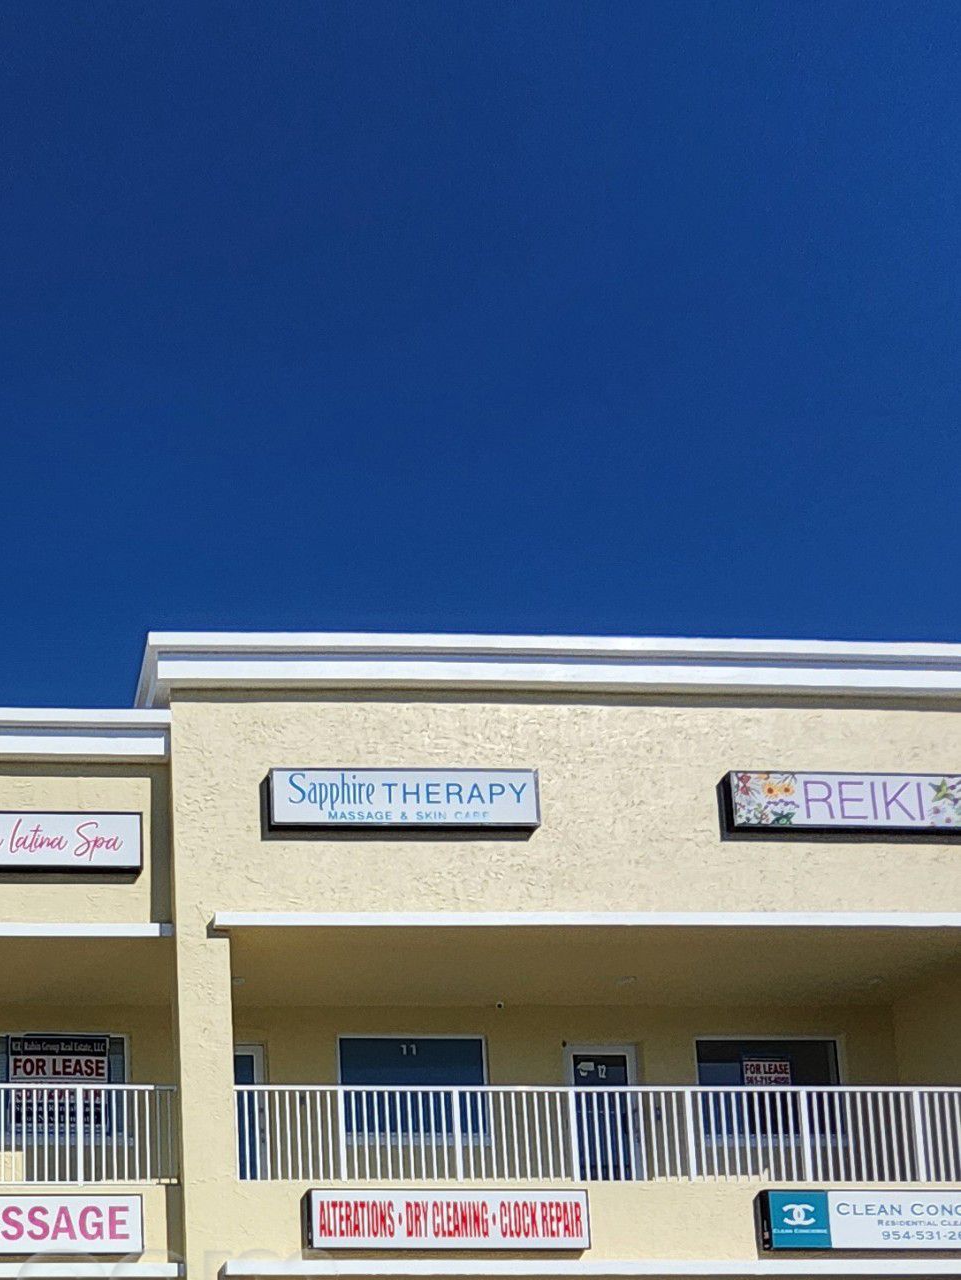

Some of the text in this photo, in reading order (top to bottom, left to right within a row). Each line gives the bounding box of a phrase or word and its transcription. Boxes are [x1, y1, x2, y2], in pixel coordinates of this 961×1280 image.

[288, 772, 527, 811] Sapphire THERAPY
[803, 780, 926, 820] REIKI
[328, 811, 393, 821] MASSAGE
[400, 811, 409, 821] &
[416, 811, 447, 821] SKIN
[9, 818, 68, 854] Latina
[73, 821, 124, 861] Spa
[400, 1044, 417, 1056] 11
[13, 1058, 105, 1077] FOR LEASE
[745, 1063, 790, 1075] FOR LEASE
[836, 1203, 902, 1216] CLEAN
[319, 1201, 584, 1238] ALTERATIONS DRY CLEANING CLOCK REPAIR
